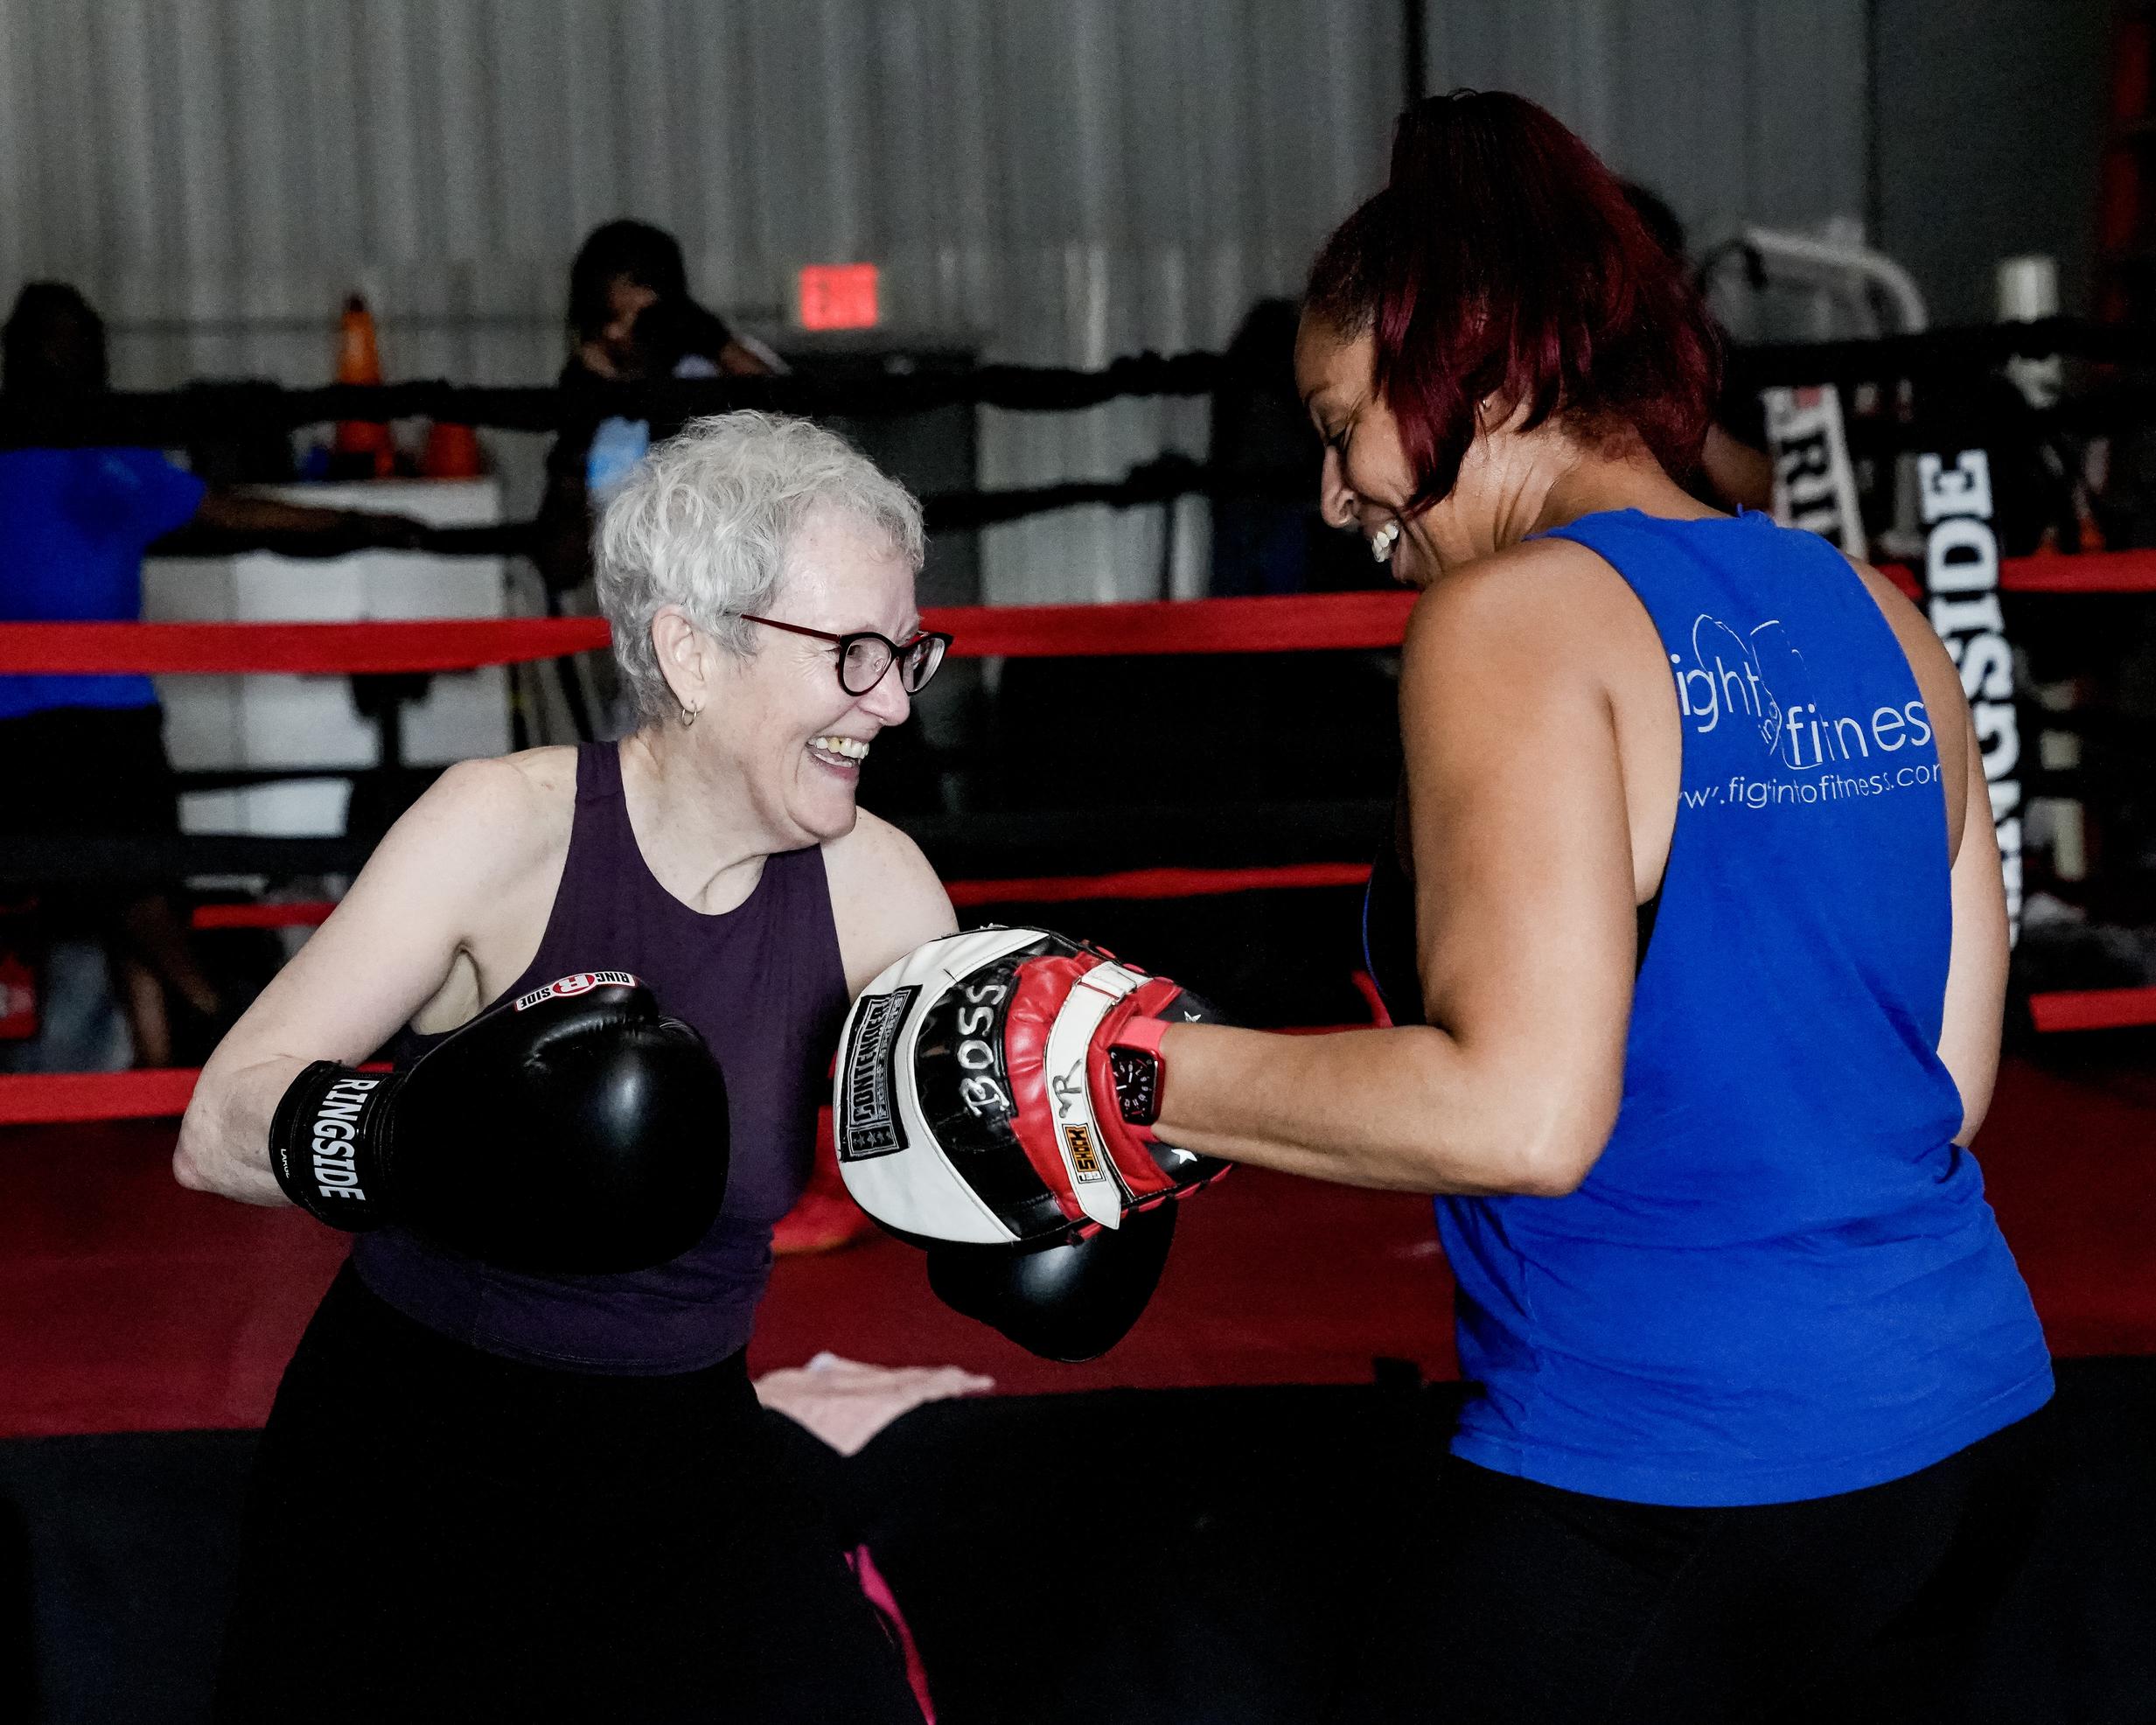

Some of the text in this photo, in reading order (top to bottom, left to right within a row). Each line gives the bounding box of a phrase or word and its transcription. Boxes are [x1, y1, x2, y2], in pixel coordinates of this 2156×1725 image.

[1782, 431, 1843, 549] RI
[1670, 653, 1760, 732] ight
[1786, 701, 1931, 765] fitnes
[1918, 449, 2022, 948] GSIDE
[520, 988, 551, 1008] SIDE
[596, 972, 630, 983] RING
[853, 1001, 890, 1122] CONTENDER
[957, 985, 1010, 1117] BOSS
[311, 1079, 380, 1201] RINGSIDE
[1068, 1128, 1096, 1170] SHOCK
